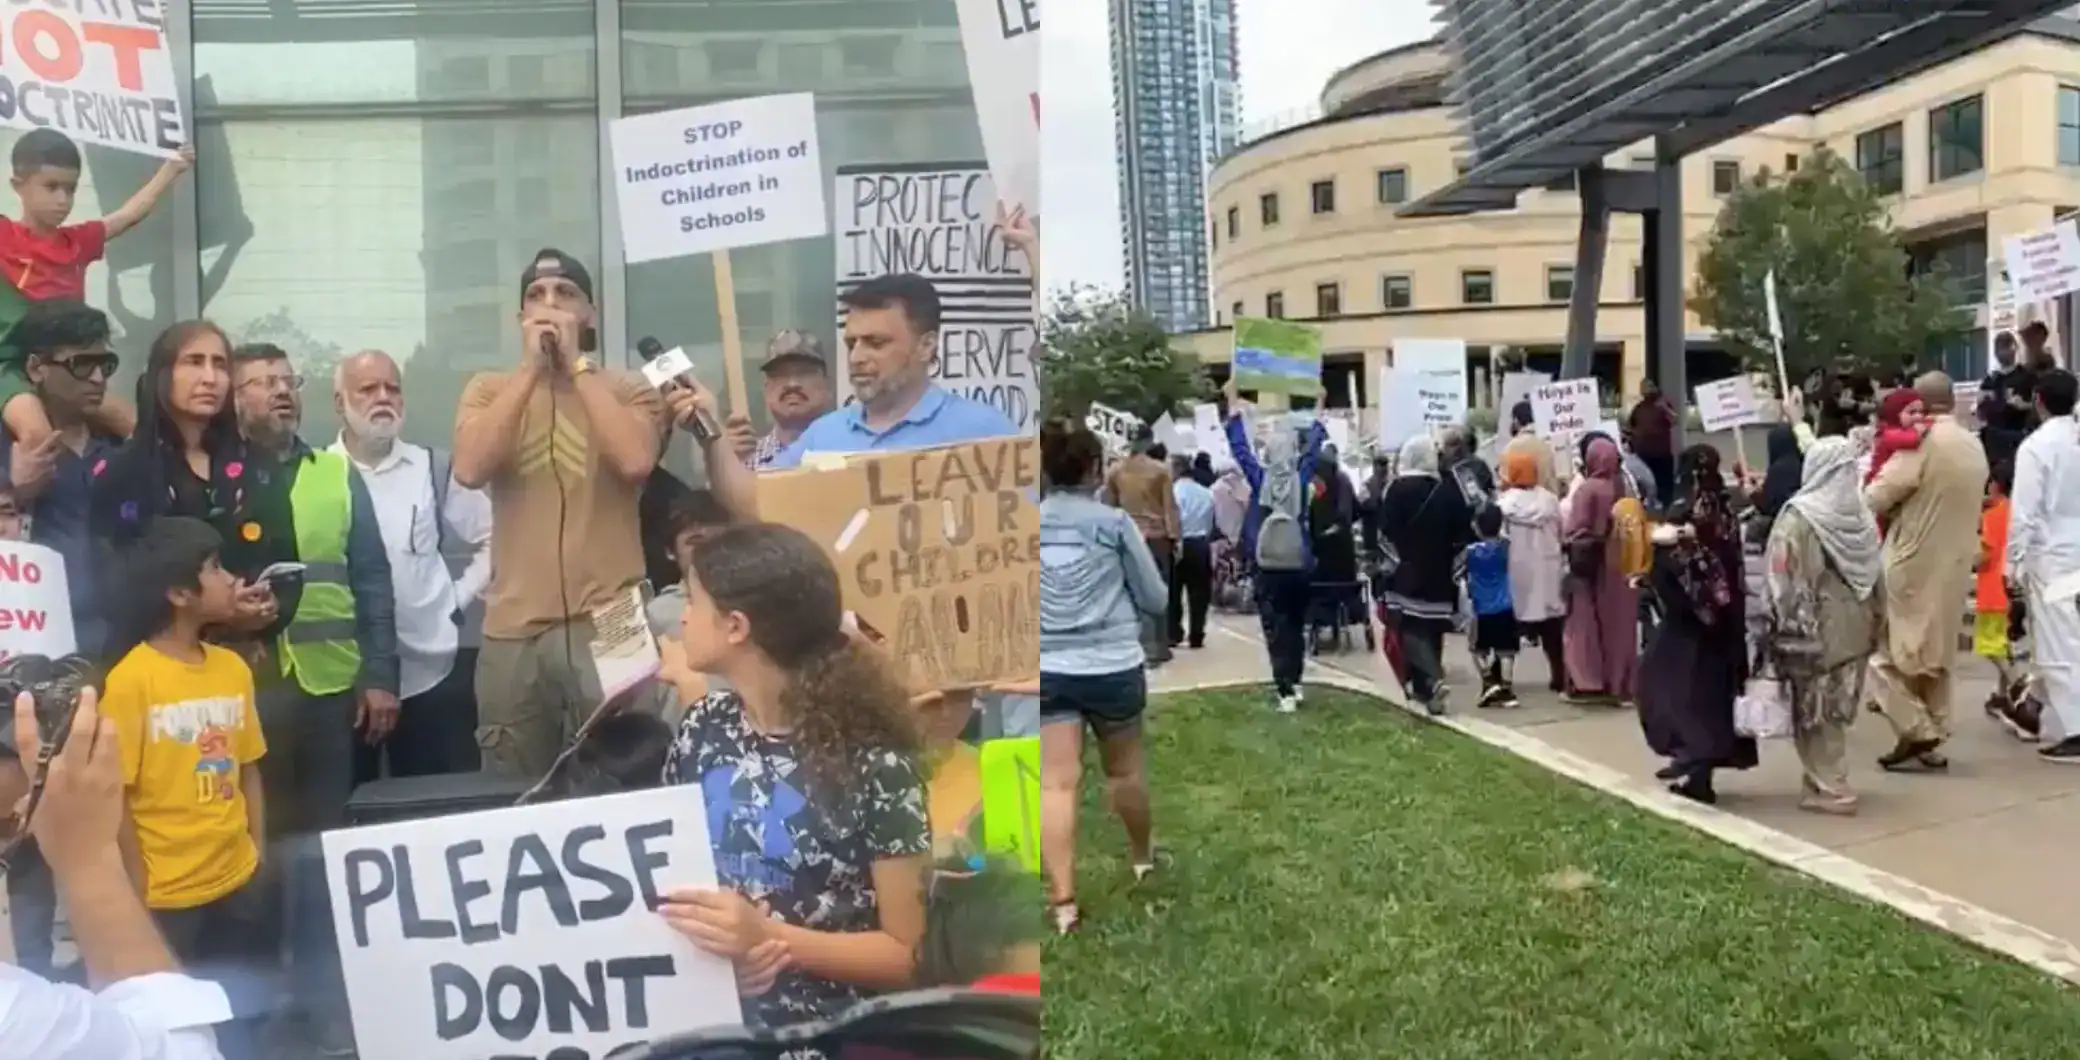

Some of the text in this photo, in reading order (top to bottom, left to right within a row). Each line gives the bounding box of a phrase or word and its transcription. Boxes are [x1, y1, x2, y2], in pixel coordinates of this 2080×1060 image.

[0, 9, 161, 91] OT
[684, 120, 742, 144] STOP
[626, 140, 807, 183] Indoctrination of
[661, 174, 779, 206] Children in
[853, 173, 981, 227] PROTEC
[680, 205, 766, 232] Schools
[865, 440, 1035, 506] LEAVE
[899, 490, 1019, 551] OUR
[0, 553, 41, 584] No
[344, 819, 673, 947] PLEASE
[430, 955, 677, 1041] DONT
